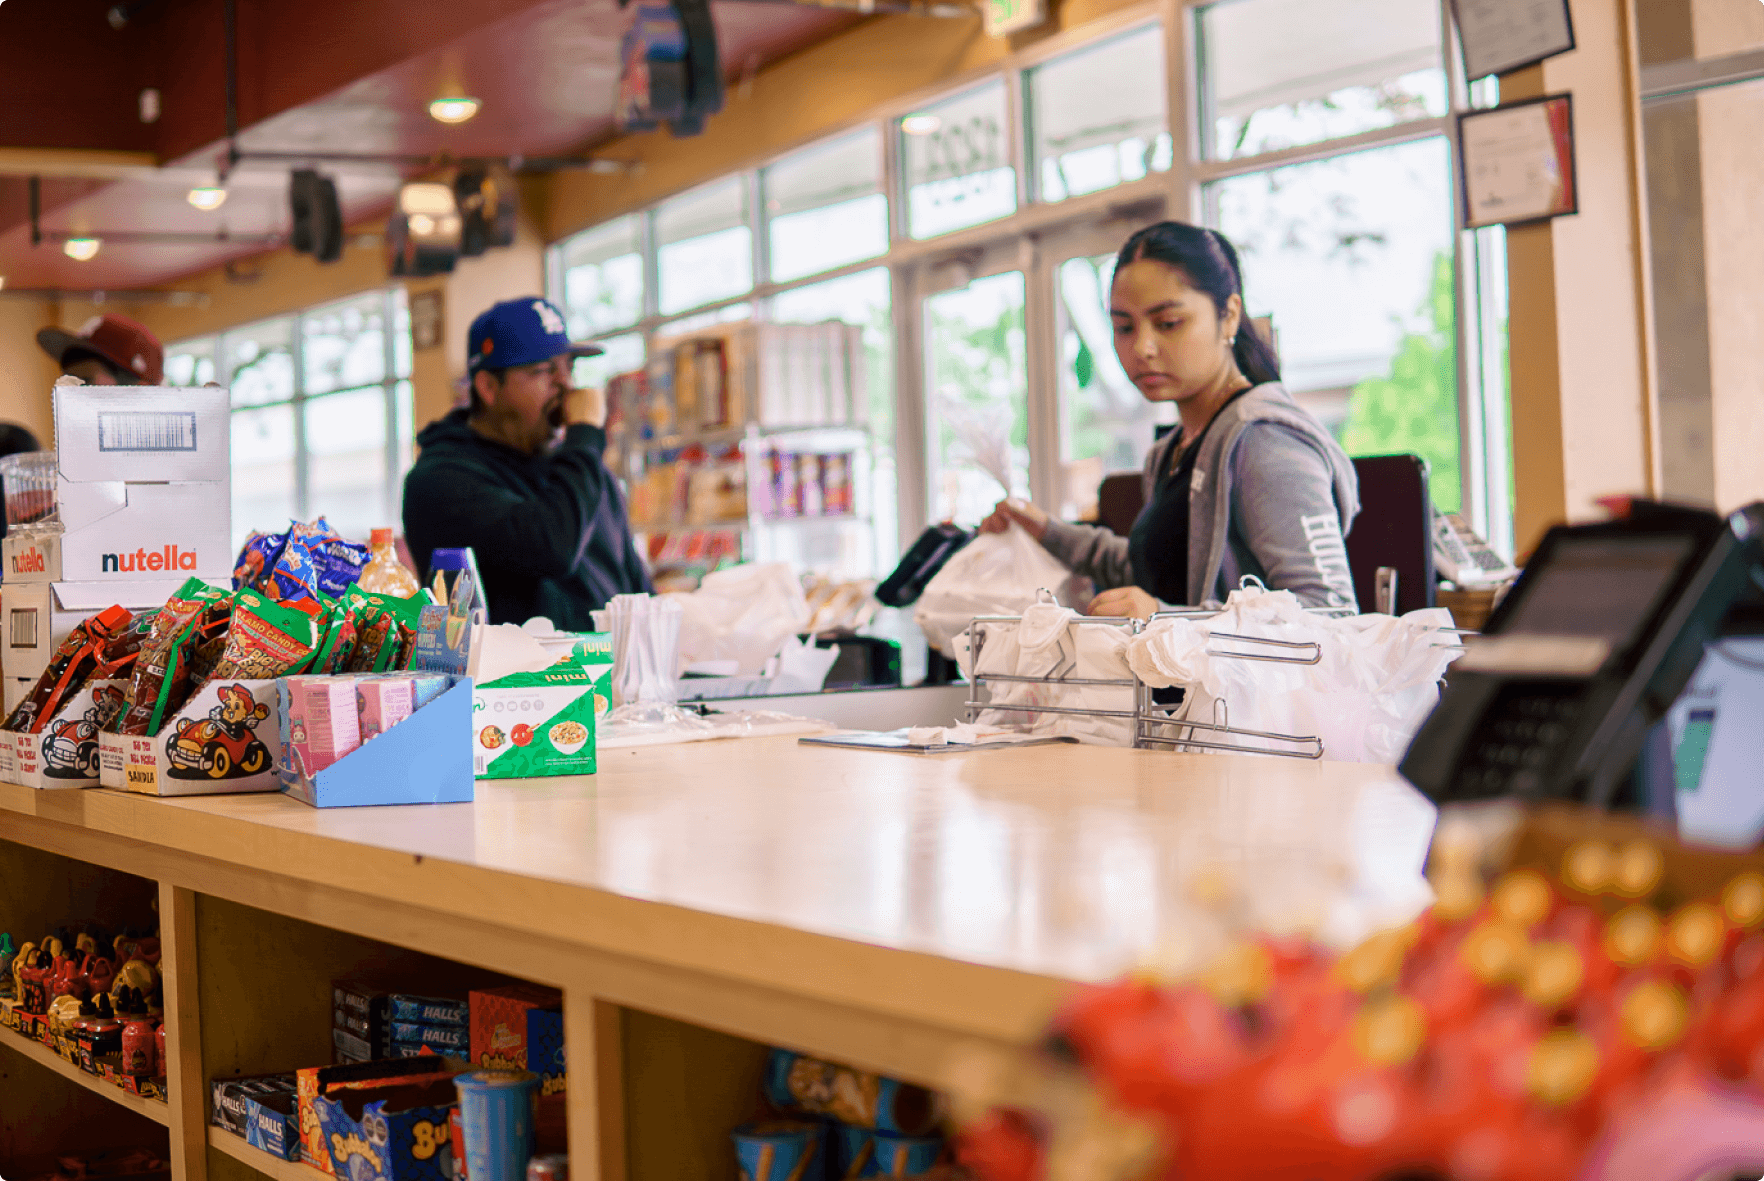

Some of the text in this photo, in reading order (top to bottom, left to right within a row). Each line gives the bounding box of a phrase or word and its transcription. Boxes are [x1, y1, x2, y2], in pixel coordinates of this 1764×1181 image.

[11, 546, 45, 573] nutella
[102, 544, 196, 572] nutella
[423, 1006, 460, 1021] HALLS
[423, 1029, 460, 1044] HALLS
[258, 1113, 283, 1137] HALLS
